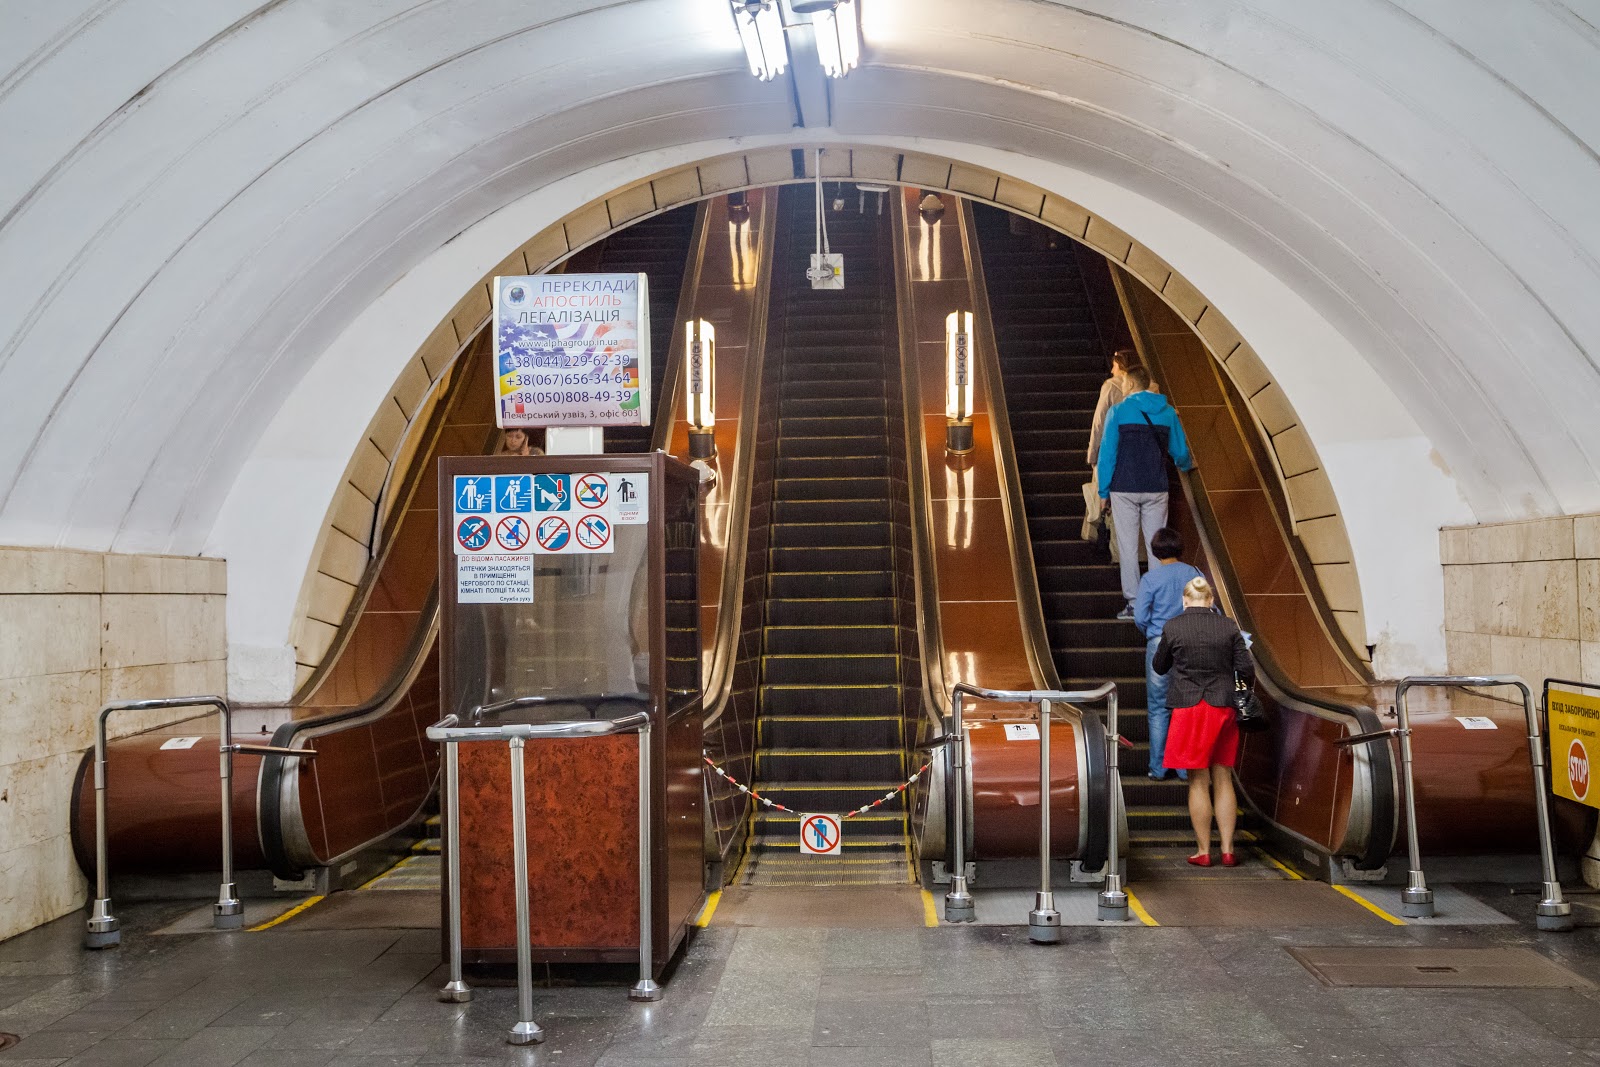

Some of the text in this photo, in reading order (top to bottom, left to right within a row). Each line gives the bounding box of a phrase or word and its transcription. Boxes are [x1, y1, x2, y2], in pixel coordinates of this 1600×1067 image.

[542, 280, 636, 293] ПЕРЕКЛАДИ
[533, 295, 622, 308] АПОСТИЛЬ
[518, 310, 620, 324] ЛЕГАЛІЗАЦІЯ
[518, 338, 618, 348] www.alphagroup.in.ua
[506, 354, 630, 368] +38(044)229-62-39
[506, 373, 630, 387] +38(067)656-34-64
[508, 390, 631, 404] +38(050)808-49-39
[504, 409, 639, 420] Печерський узвіз, 3, офіс 603
[1552, 701, 1600, 720] ВХІД ЗАБОРОНЕНО
[1570, 756, 1587, 784] STOP
